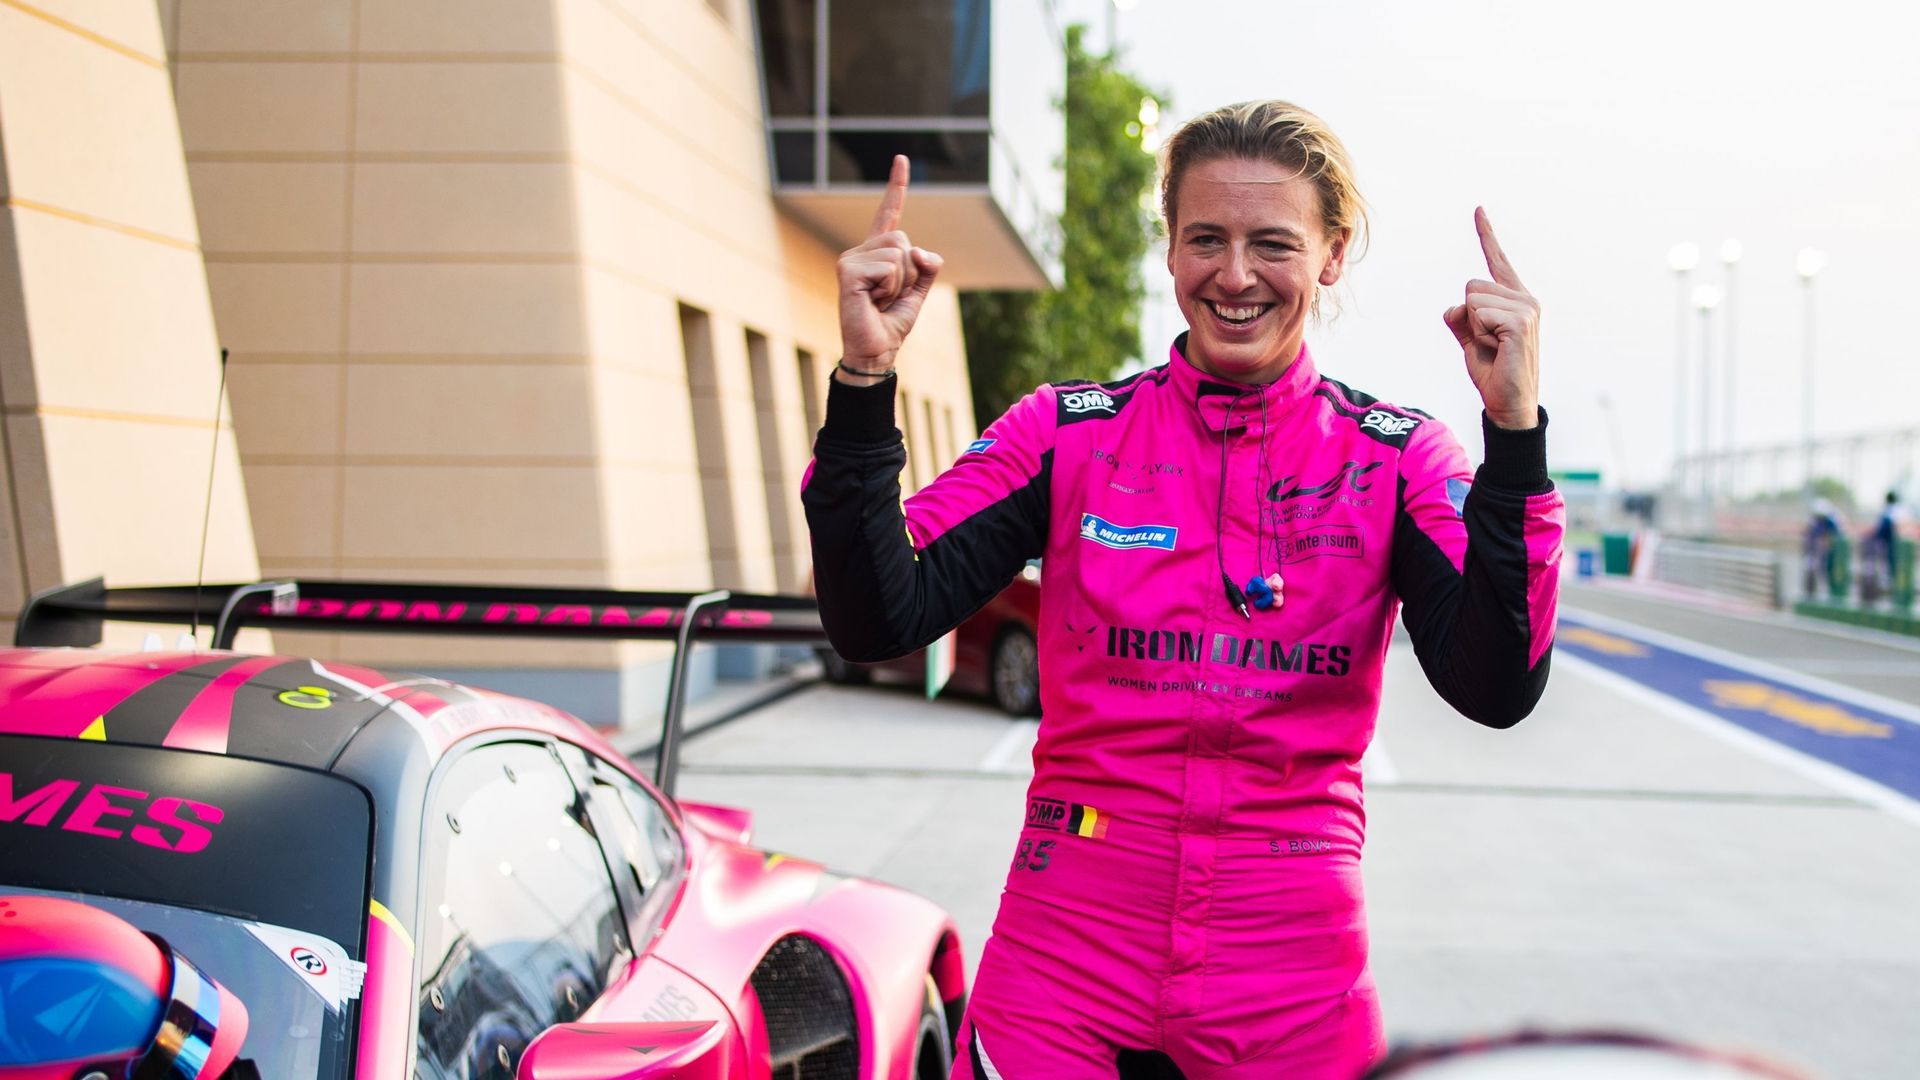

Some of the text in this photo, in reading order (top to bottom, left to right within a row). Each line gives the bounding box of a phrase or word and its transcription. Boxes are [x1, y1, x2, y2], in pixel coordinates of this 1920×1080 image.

[1063, 393, 1115, 410] OMP
[1364, 412, 1415, 432] OMP
[1149, 464, 1184, 477] LYNX
[1099, 528, 1166, 542] MICHELIN
[1295, 534, 1359, 553] intensum
[259, 599, 774, 628] RON DAMS
[1107, 626, 1352, 676] IRON DAMES
[1107, 676, 1157, 692] WOMEN
[1212, 683, 1230, 695] BY
[1235, 687, 1293, 702] DREAMS
[1028, 802, 1065, 824] OMP
[1015, 838, 1057, 872] 85
[1269, 840, 1285, 853] S.
